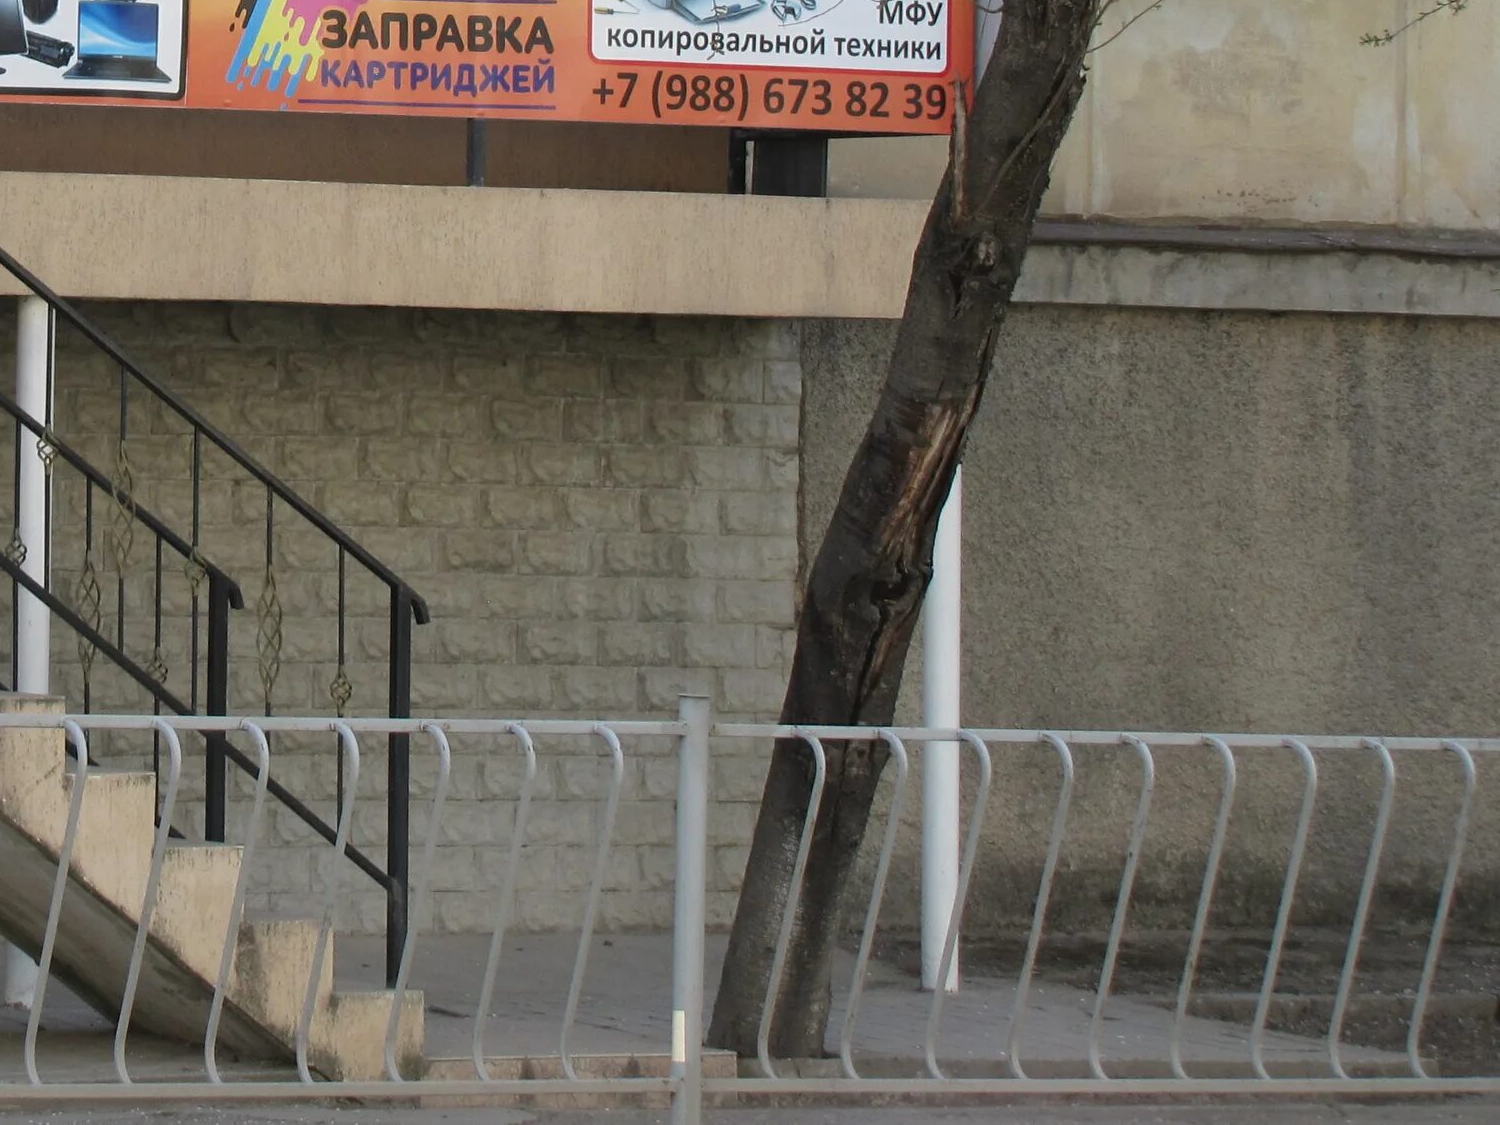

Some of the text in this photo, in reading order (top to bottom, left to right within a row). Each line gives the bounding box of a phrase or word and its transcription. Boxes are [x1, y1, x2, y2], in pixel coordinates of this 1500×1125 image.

[321, 9, 555, 54] ЗАПРАВКА
[878, 0, 943, 26] МФУ
[607, 27, 942, 60] копировальной техники
[321, 58, 555, 98] КАРТРИДЖЕЙ
[592, 70, 946, 121] +7 (988) 673 82 39
